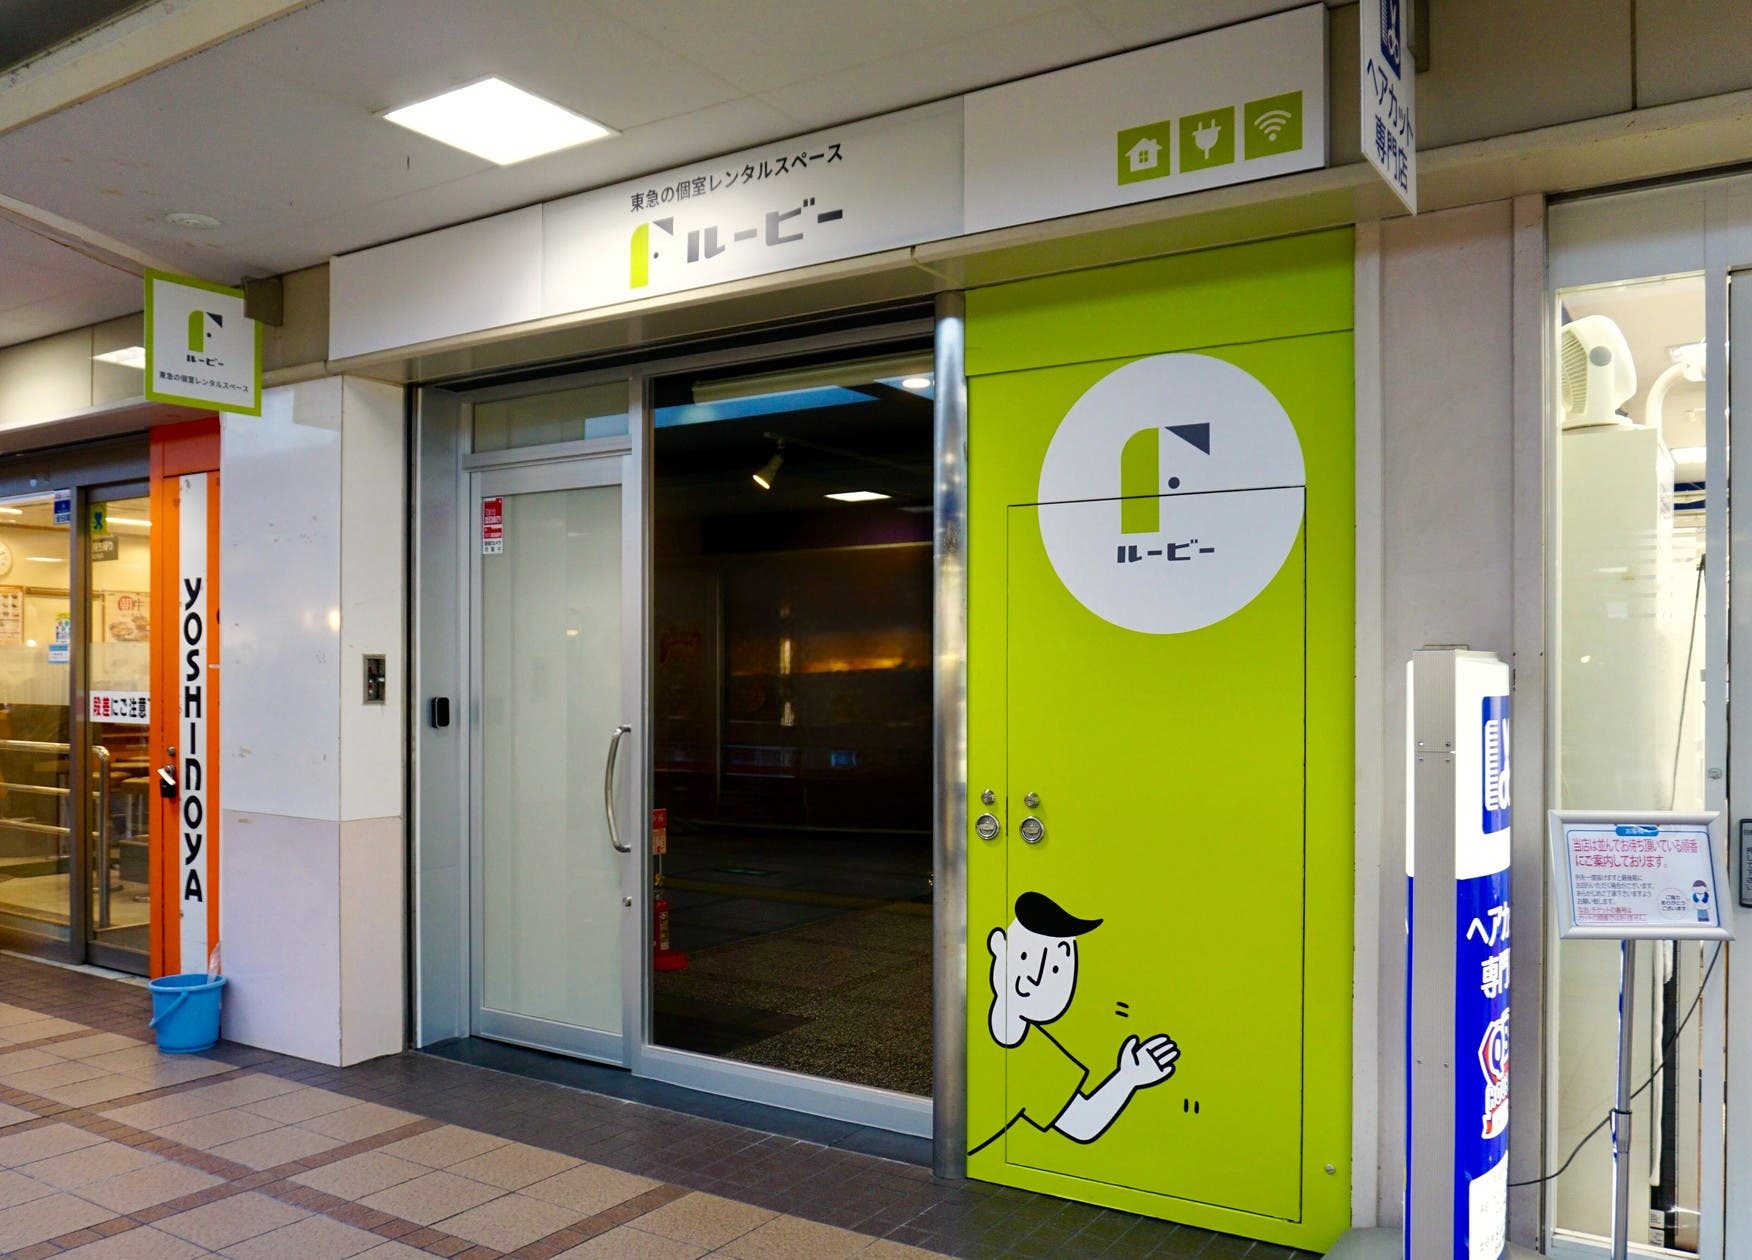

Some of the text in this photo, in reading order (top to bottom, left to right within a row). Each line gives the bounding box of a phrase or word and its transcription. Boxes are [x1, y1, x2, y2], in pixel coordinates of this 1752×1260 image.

[1367, 58, 1413, 146] ヘアカット
[1375, 113, 1408, 193] 専門店
[630, 143, 843, 212] 東急の個室レンタルスペース
[687, 197, 844, 265] ルービー
[160, 371, 249, 392] 東急の個室レンタルスペース
[186, 354, 224, 366] ルービー
[1116, 539, 1215, 563] ルービー
[1576, 855, 1668, 868] にご案内しております。
